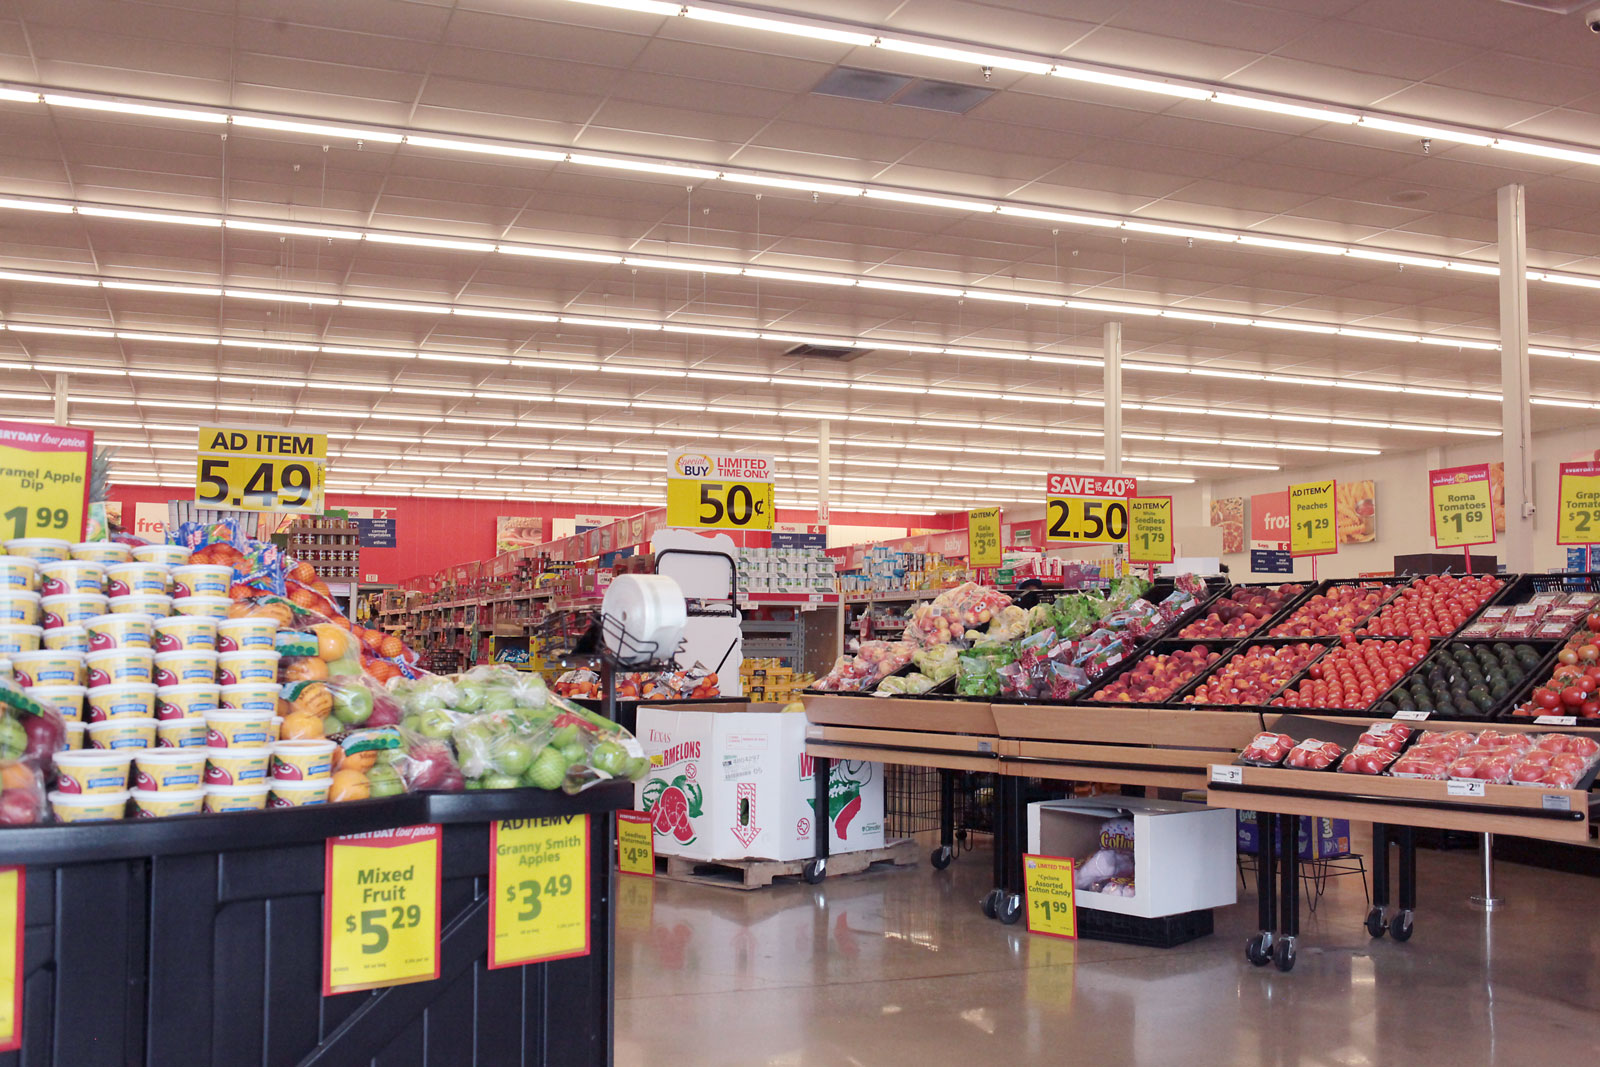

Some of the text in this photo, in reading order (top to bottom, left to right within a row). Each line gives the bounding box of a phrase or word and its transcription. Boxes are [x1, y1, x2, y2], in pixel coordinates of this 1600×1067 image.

[210, 432, 314, 455] AD ITEM
[717, 457, 767, 470] LIMITED
[43, 470, 82, 484] Apple
[685, 466, 709, 476] BUY
[718, 468, 770, 479] TIME ONLY
[21, 479, 44, 492] Dip
[199, 459, 311, 508] 5.49
[1050, 476, 1095, 494] SAVE
[1102, 479, 1135, 496] 40%
[1292, 487, 1322, 497] AD ITEM
[699, 483, 764, 526] 50¢
[1297, 502, 1328, 511] Peaches
[1438, 502, 1486, 511] Tomatoes
[380, 510, 388, 519] 2
[1049, 500, 1128, 539] 2.50
[1134, 516, 1165, 524] Seedless
[137, 518, 170, 533] fre
[812, 525, 820, 534] 4
[1137, 525, 1163, 533] Grapes
[649, 729, 671, 743] TEXAS
[501, 815, 562, 831] AD ITEM
[395, 827, 411, 838] low
[411, 825, 436, 839] price
[625, 831, 647, 839] Seedless
[497, 836, 581, 856] Granny Smith
[519, 852, 561, 867] Apples
[357, 865, 414, 885] Mixed
[1028, 885, 1071, 898] Cotton Candy
[1035, 880, 1063, 890] Assorted
[363, 885, 406, 904] Fruit
